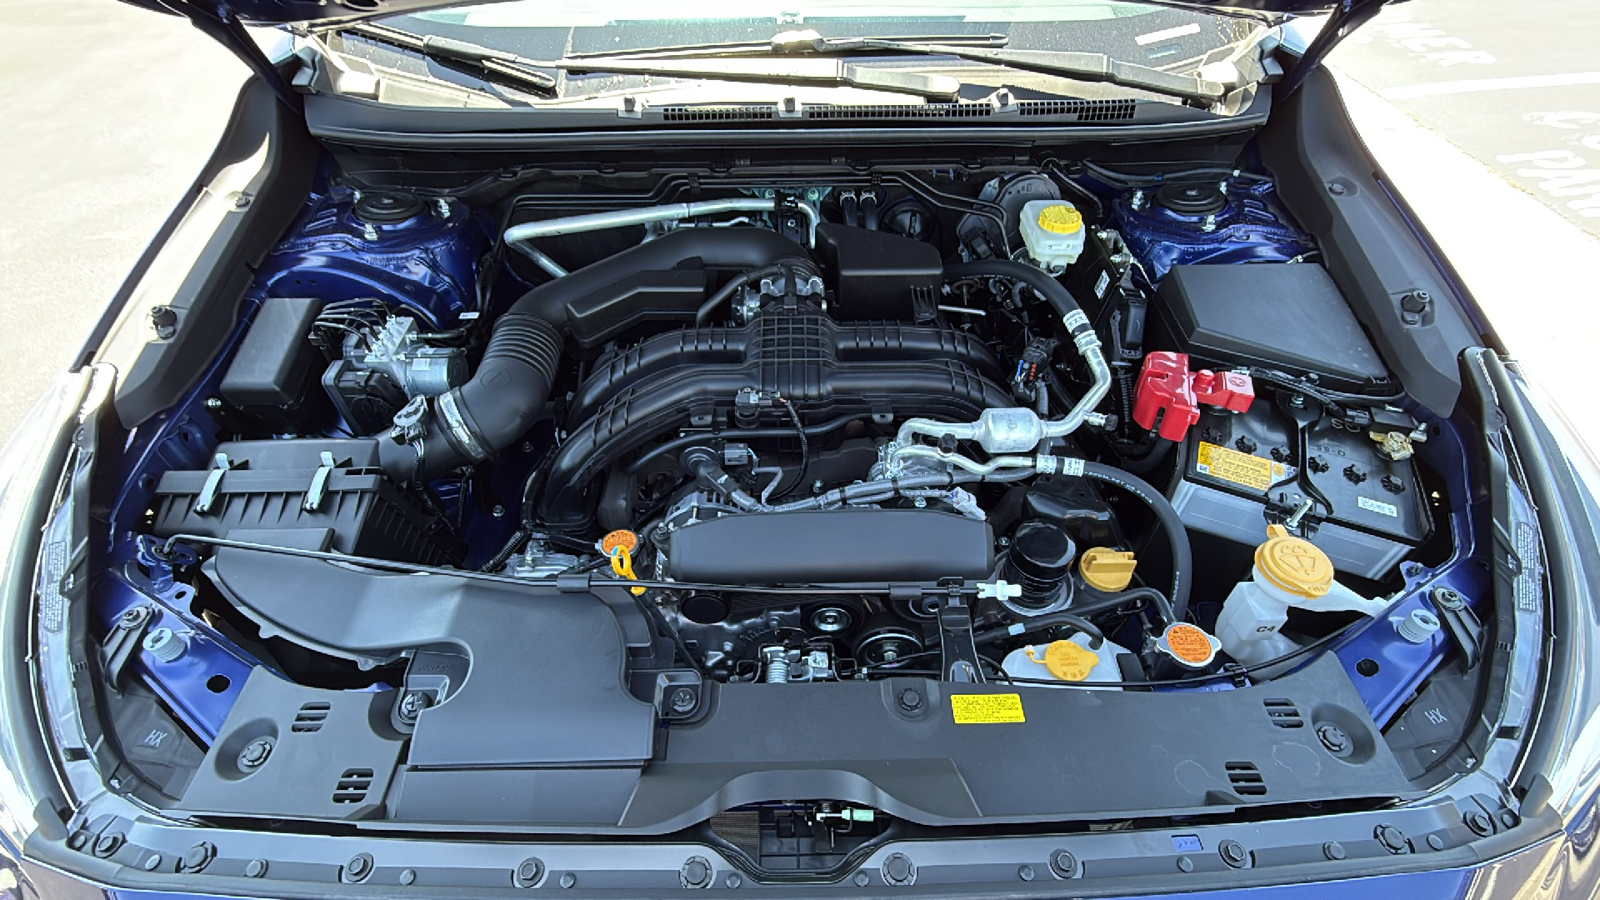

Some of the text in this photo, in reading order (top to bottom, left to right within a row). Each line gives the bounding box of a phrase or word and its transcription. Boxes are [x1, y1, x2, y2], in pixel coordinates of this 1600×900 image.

[1256, 625, 1276, 633] C4
[1424, 707, 1449, 725] HX
[144, 729, 168, 748] HX
